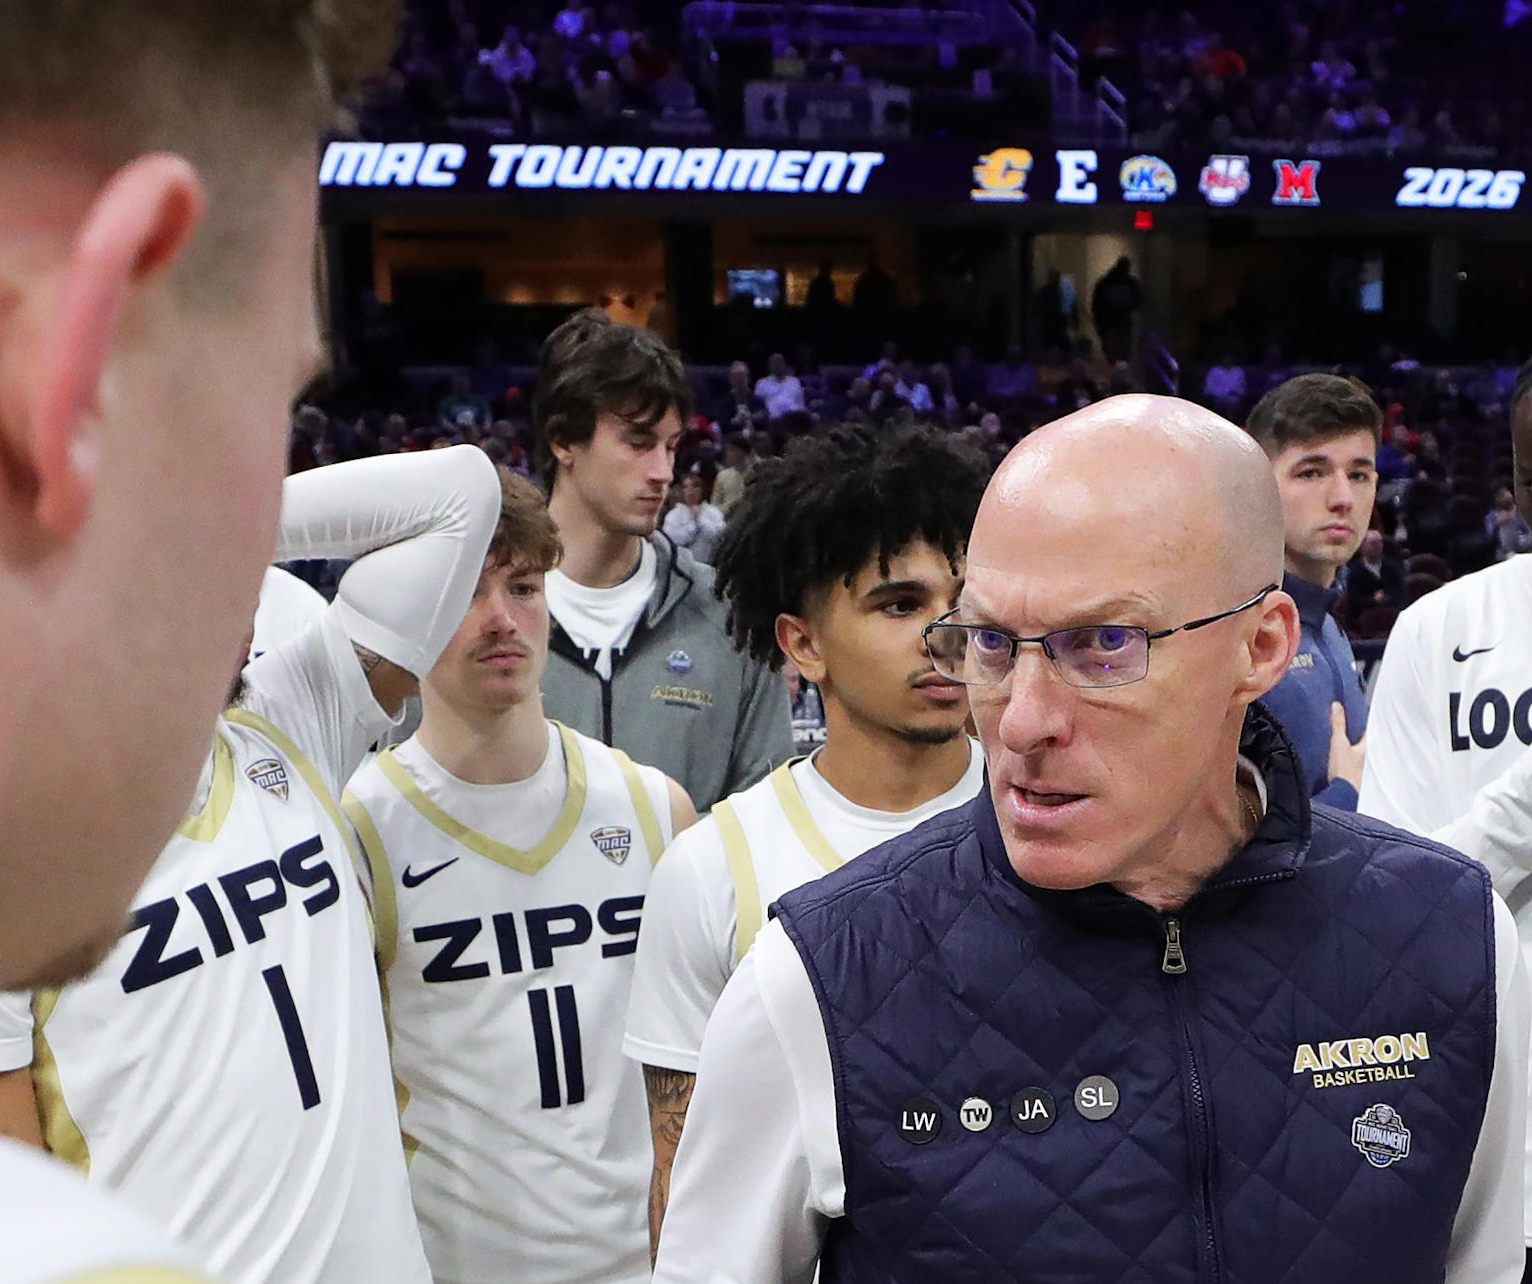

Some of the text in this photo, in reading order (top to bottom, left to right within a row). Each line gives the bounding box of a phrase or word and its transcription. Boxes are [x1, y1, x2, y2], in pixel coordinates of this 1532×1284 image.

[319, 141, 885, 194] MAC TOURNAMENT
[1055, 150, 1098, 203] E
[1272, 159, 1320, 206] M
[1395, 167, 1526, 209] 2026
[254, 769, 289, 789] MAC
[597, 836, 631, 852] MAC
[120, 834, 341, 995] ZIPS
[412, 894, 646, 983] ZIPS
[262, 963, 321, 1111] 1
[527, 984, 585, 1109] 11
[1292, 1032, 1431, 1074] AKRON
[1080, 1086, 1113, 1108] SL
[1312, 1064, 1416, 1089] BASKETBALL
[901, 1110, 936, 1132] LW
[963, 1107, 989, 1123] TW
[1018, 1099, 1049, 1121] JA
[1356, 1123, 1408, 1153] TOURNAMENT
